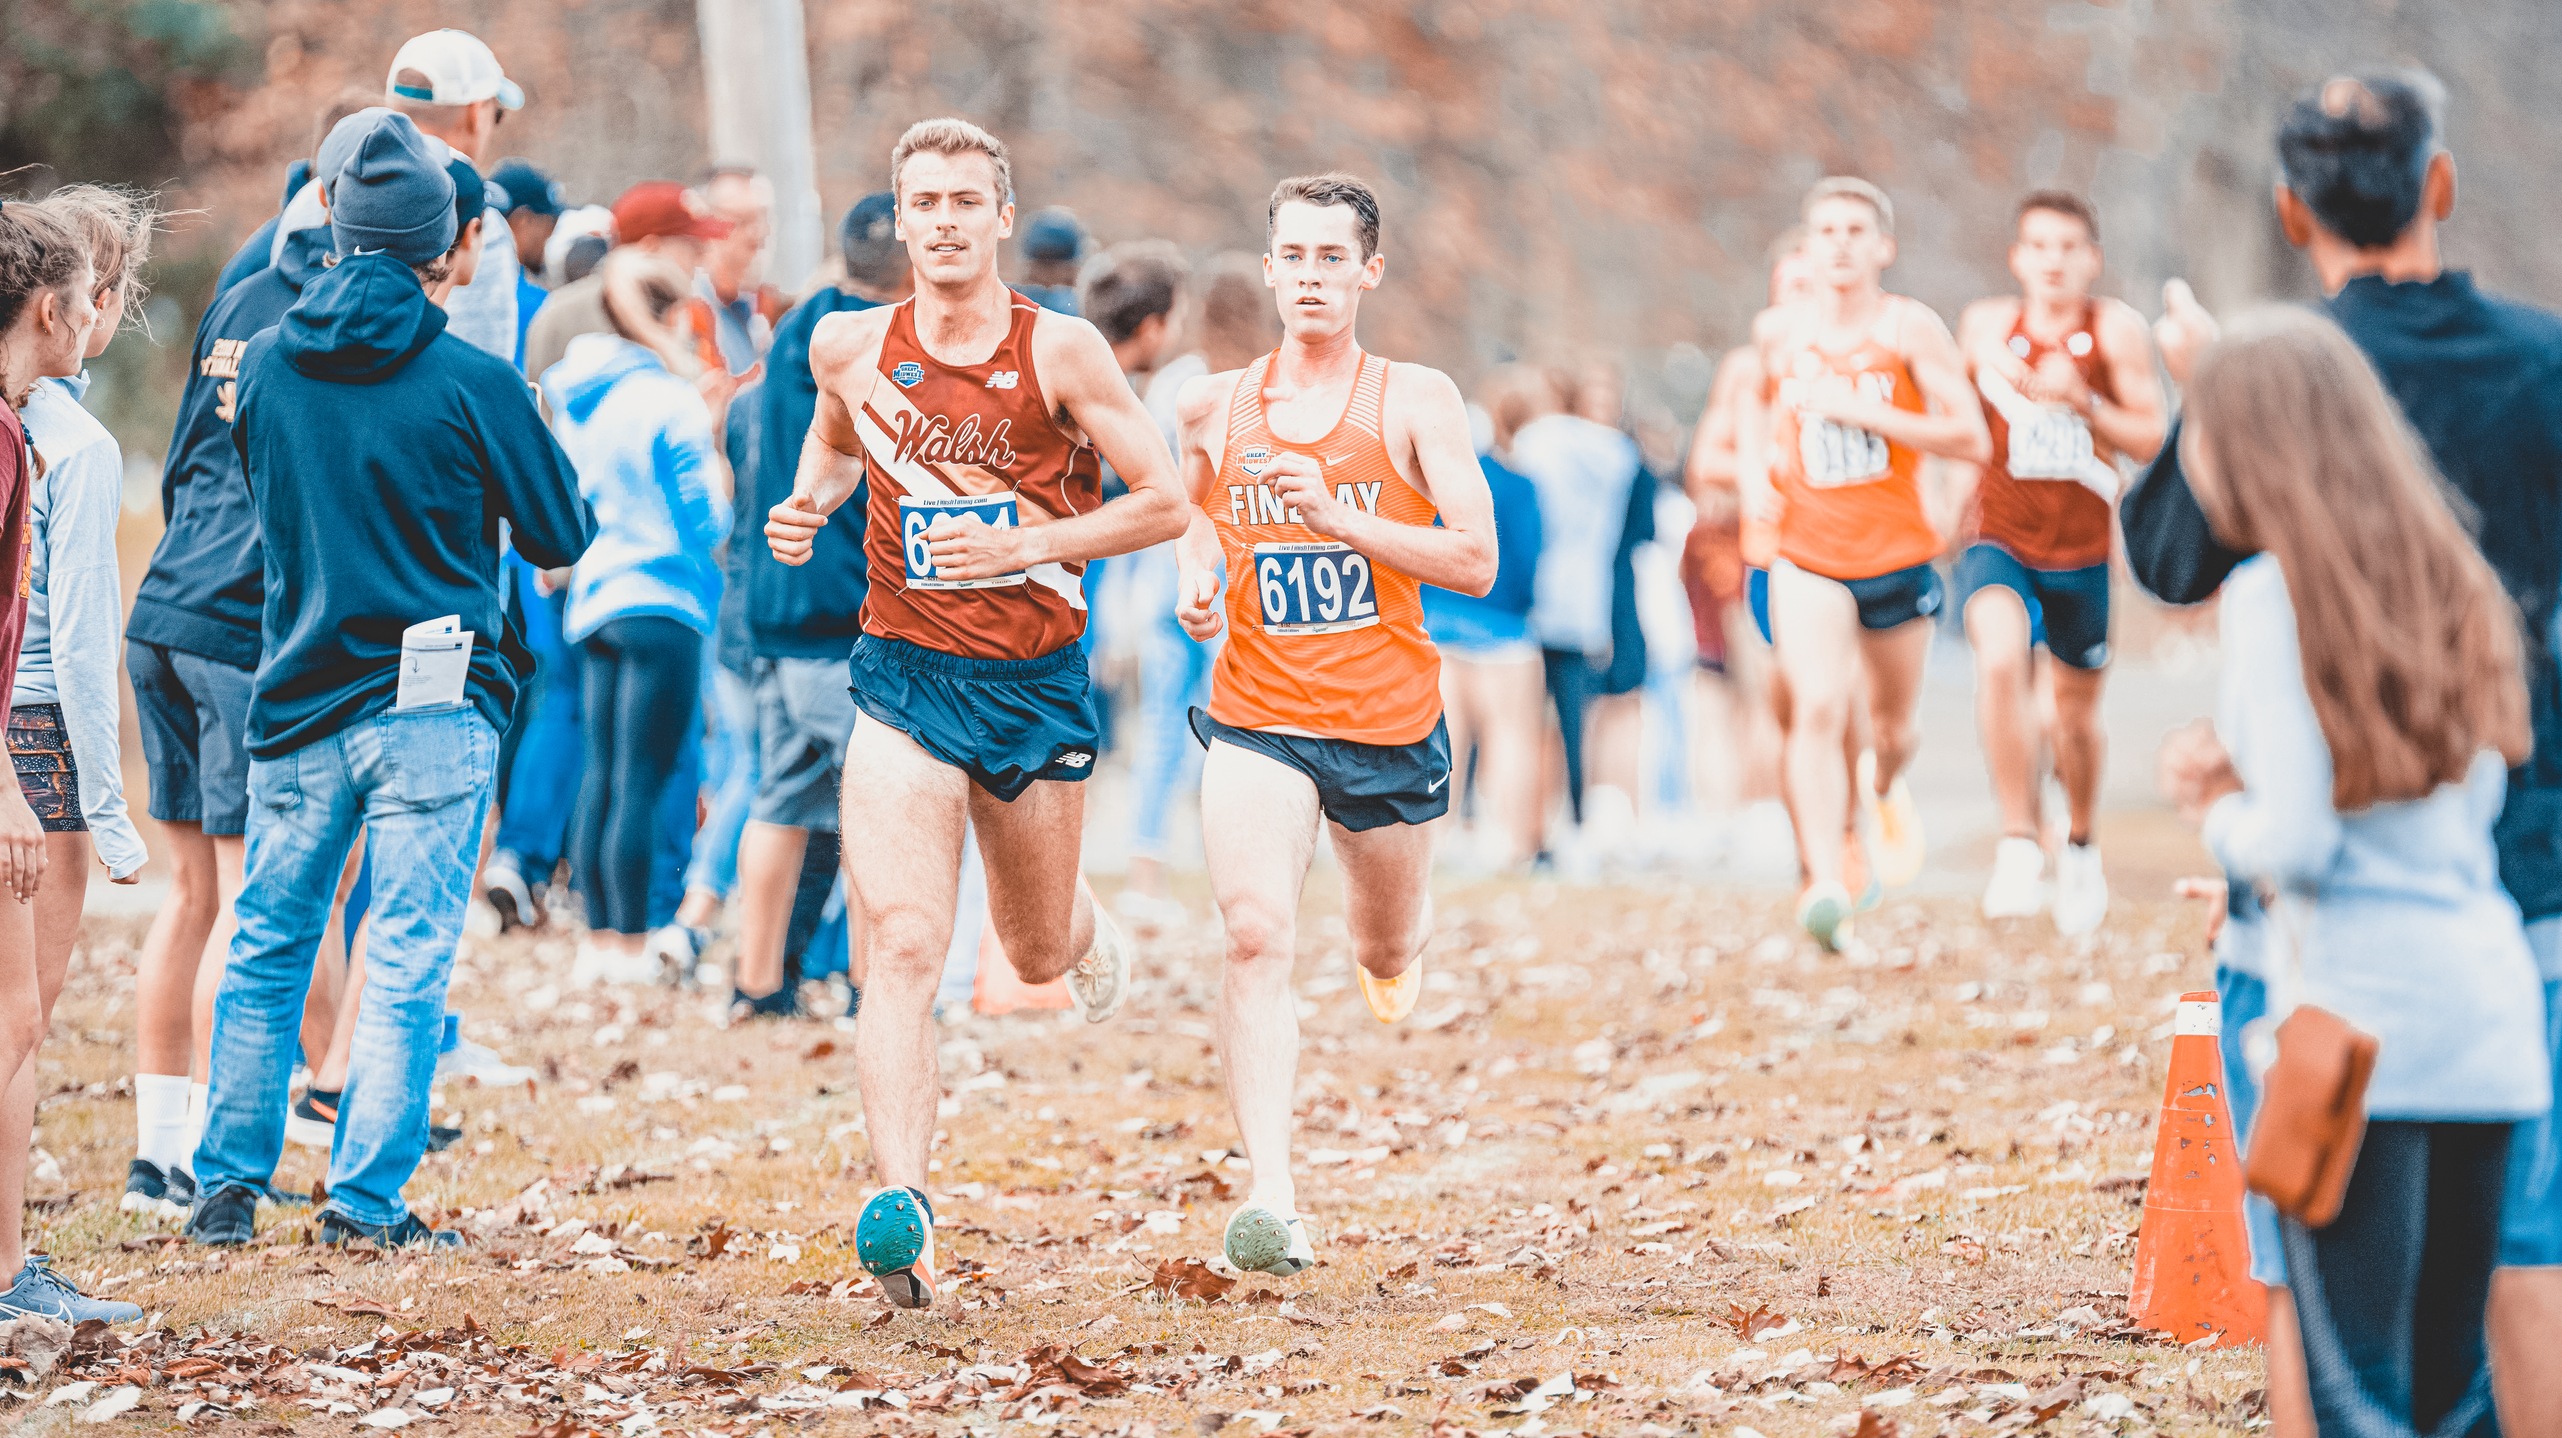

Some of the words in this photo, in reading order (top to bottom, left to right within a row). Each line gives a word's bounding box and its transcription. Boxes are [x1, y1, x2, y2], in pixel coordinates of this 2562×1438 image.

[893, 409, 1016, 470] Walsh
[1228, 481, 1383, 526] FINAY
[1259, 553, 1375, 623] 6192
